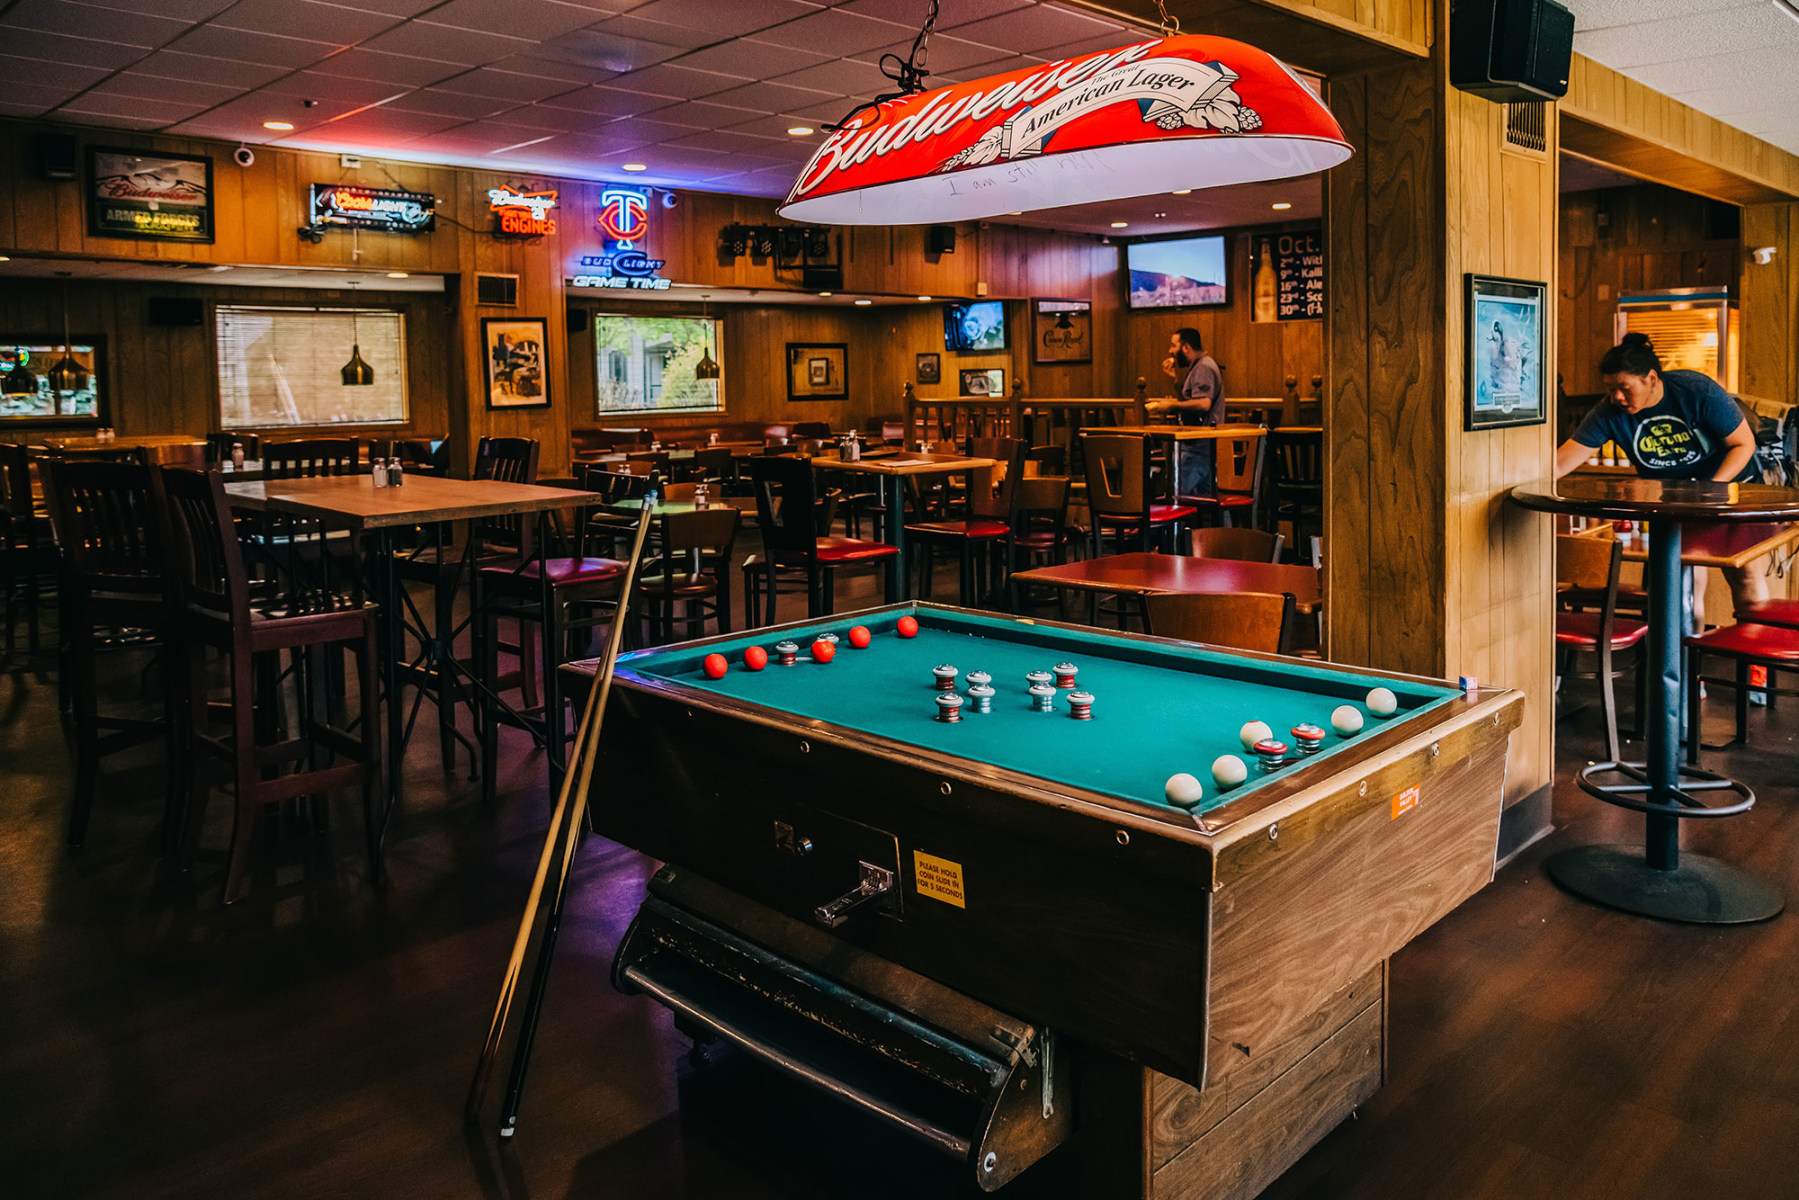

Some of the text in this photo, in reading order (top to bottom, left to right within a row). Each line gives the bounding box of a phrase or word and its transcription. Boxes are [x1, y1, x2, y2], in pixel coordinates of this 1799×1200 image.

[1091, 65, 1140, 86] The Great
[1021, 69, 1195, 140] American Lager
[785, 39, 1163, 204] Budweiser
[973, 178, 998, 190] am
[501, 215, 556, 235] ENGINES
[1279, 236, 1319, 255] Oct.
[583, 257, 612, 266] BUD
[573, 276, 672, 290] GAME TIME
[1649, 458, 1677, 467] SINCE
[919, 861, 957, 878] PLEASE HOLD
[917, 878, 928, 887] FOR
[935, 884, 963, 899] SECONDS
[919, 870, 959, 889] COIN SLIDE IN
